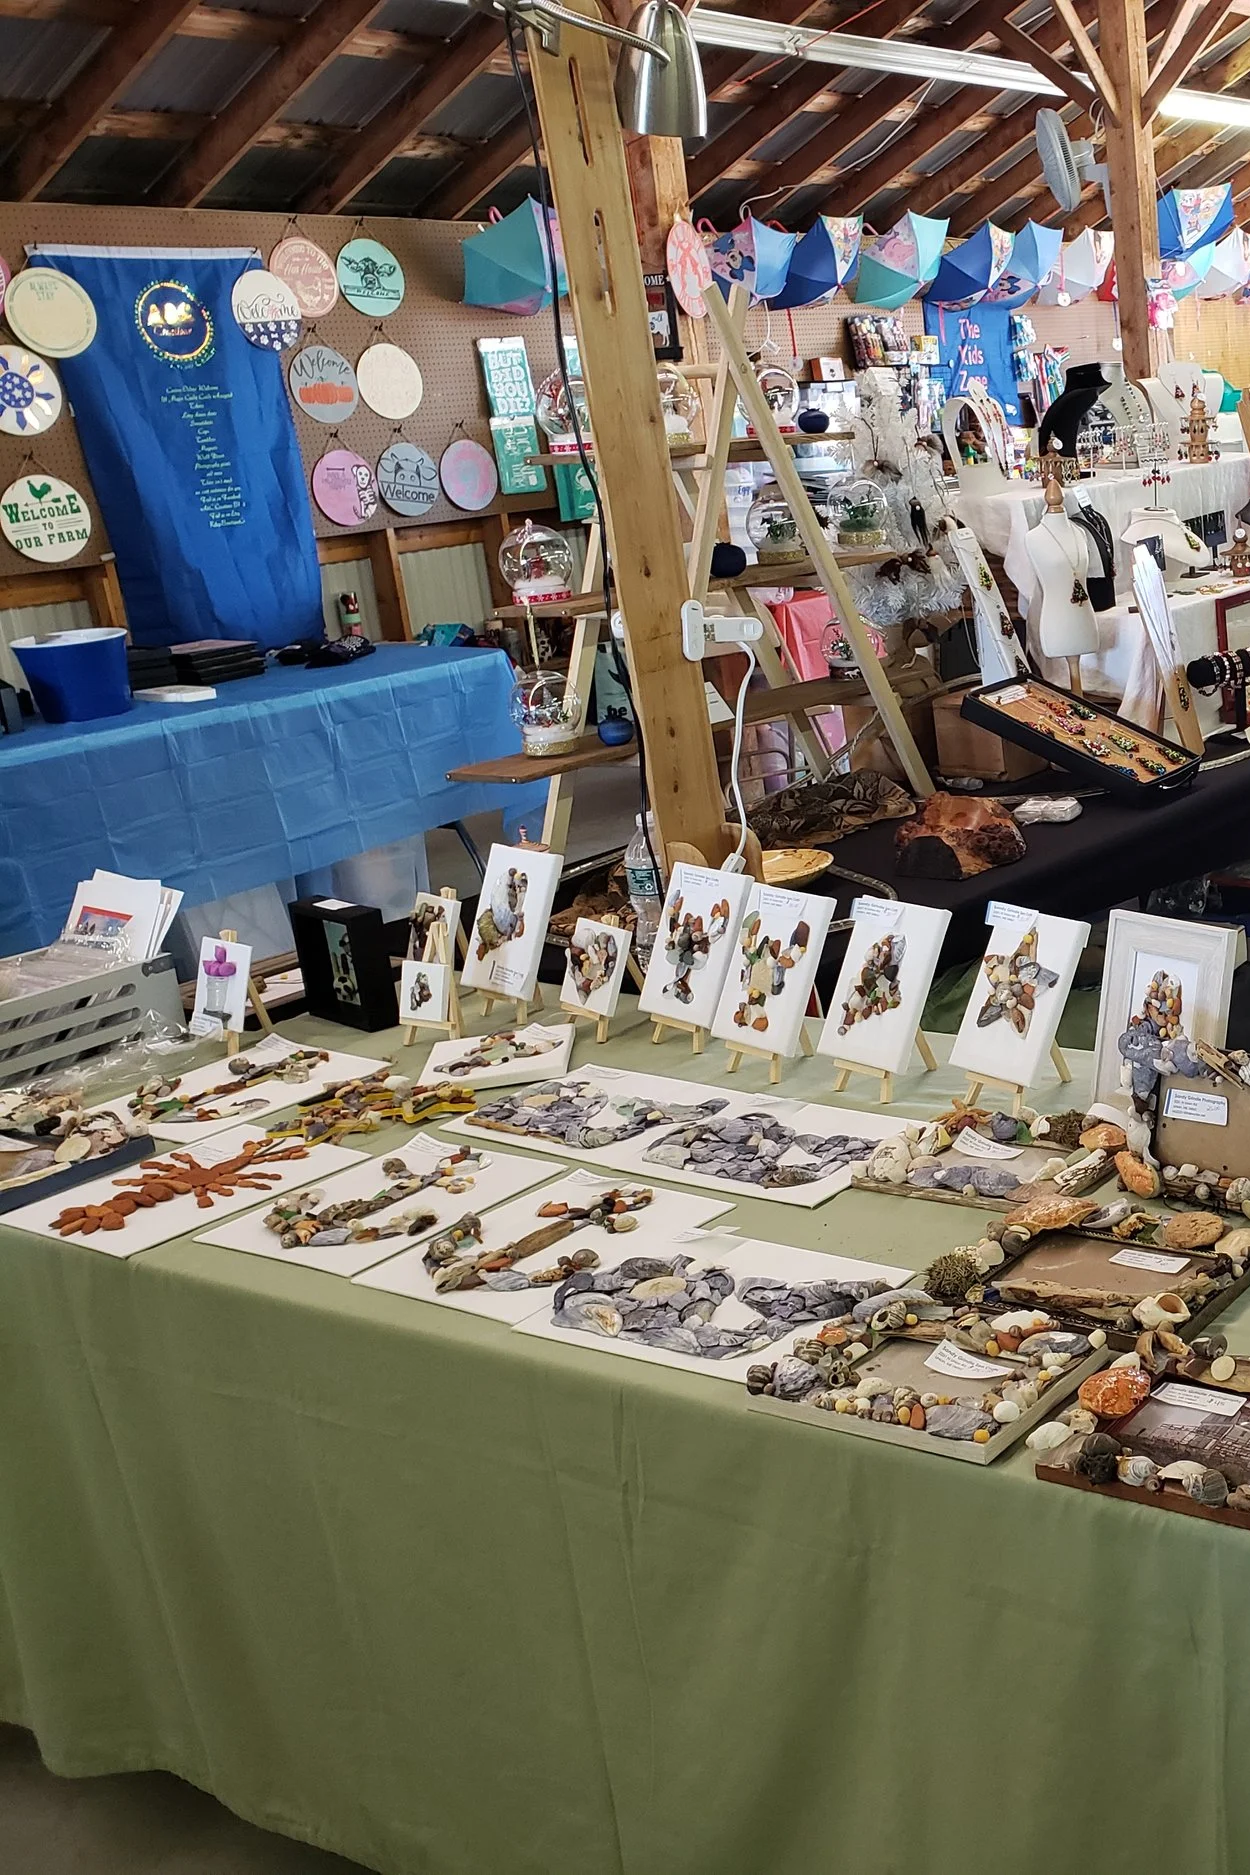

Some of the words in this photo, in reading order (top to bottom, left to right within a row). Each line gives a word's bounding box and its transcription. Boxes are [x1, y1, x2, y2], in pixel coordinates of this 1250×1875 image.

[644, 275, 665, 286] OME
[958, 318, 980, 339] The
[293, 350, 350, 378] Welcome
[487, 351, 523, 369] BUT
[958, 345, 984, 365] Kids
[490, 366, 525, 383] DID
[494, 382, 528, 398] YOU
[381, 483, 436, 501] Welcome
[2, 494, 81, 524] WELCOME
[42, 522, 54, 530] TO
[15, 536, 43, 550] OUR
[47, 528, 89, 545] FARM
